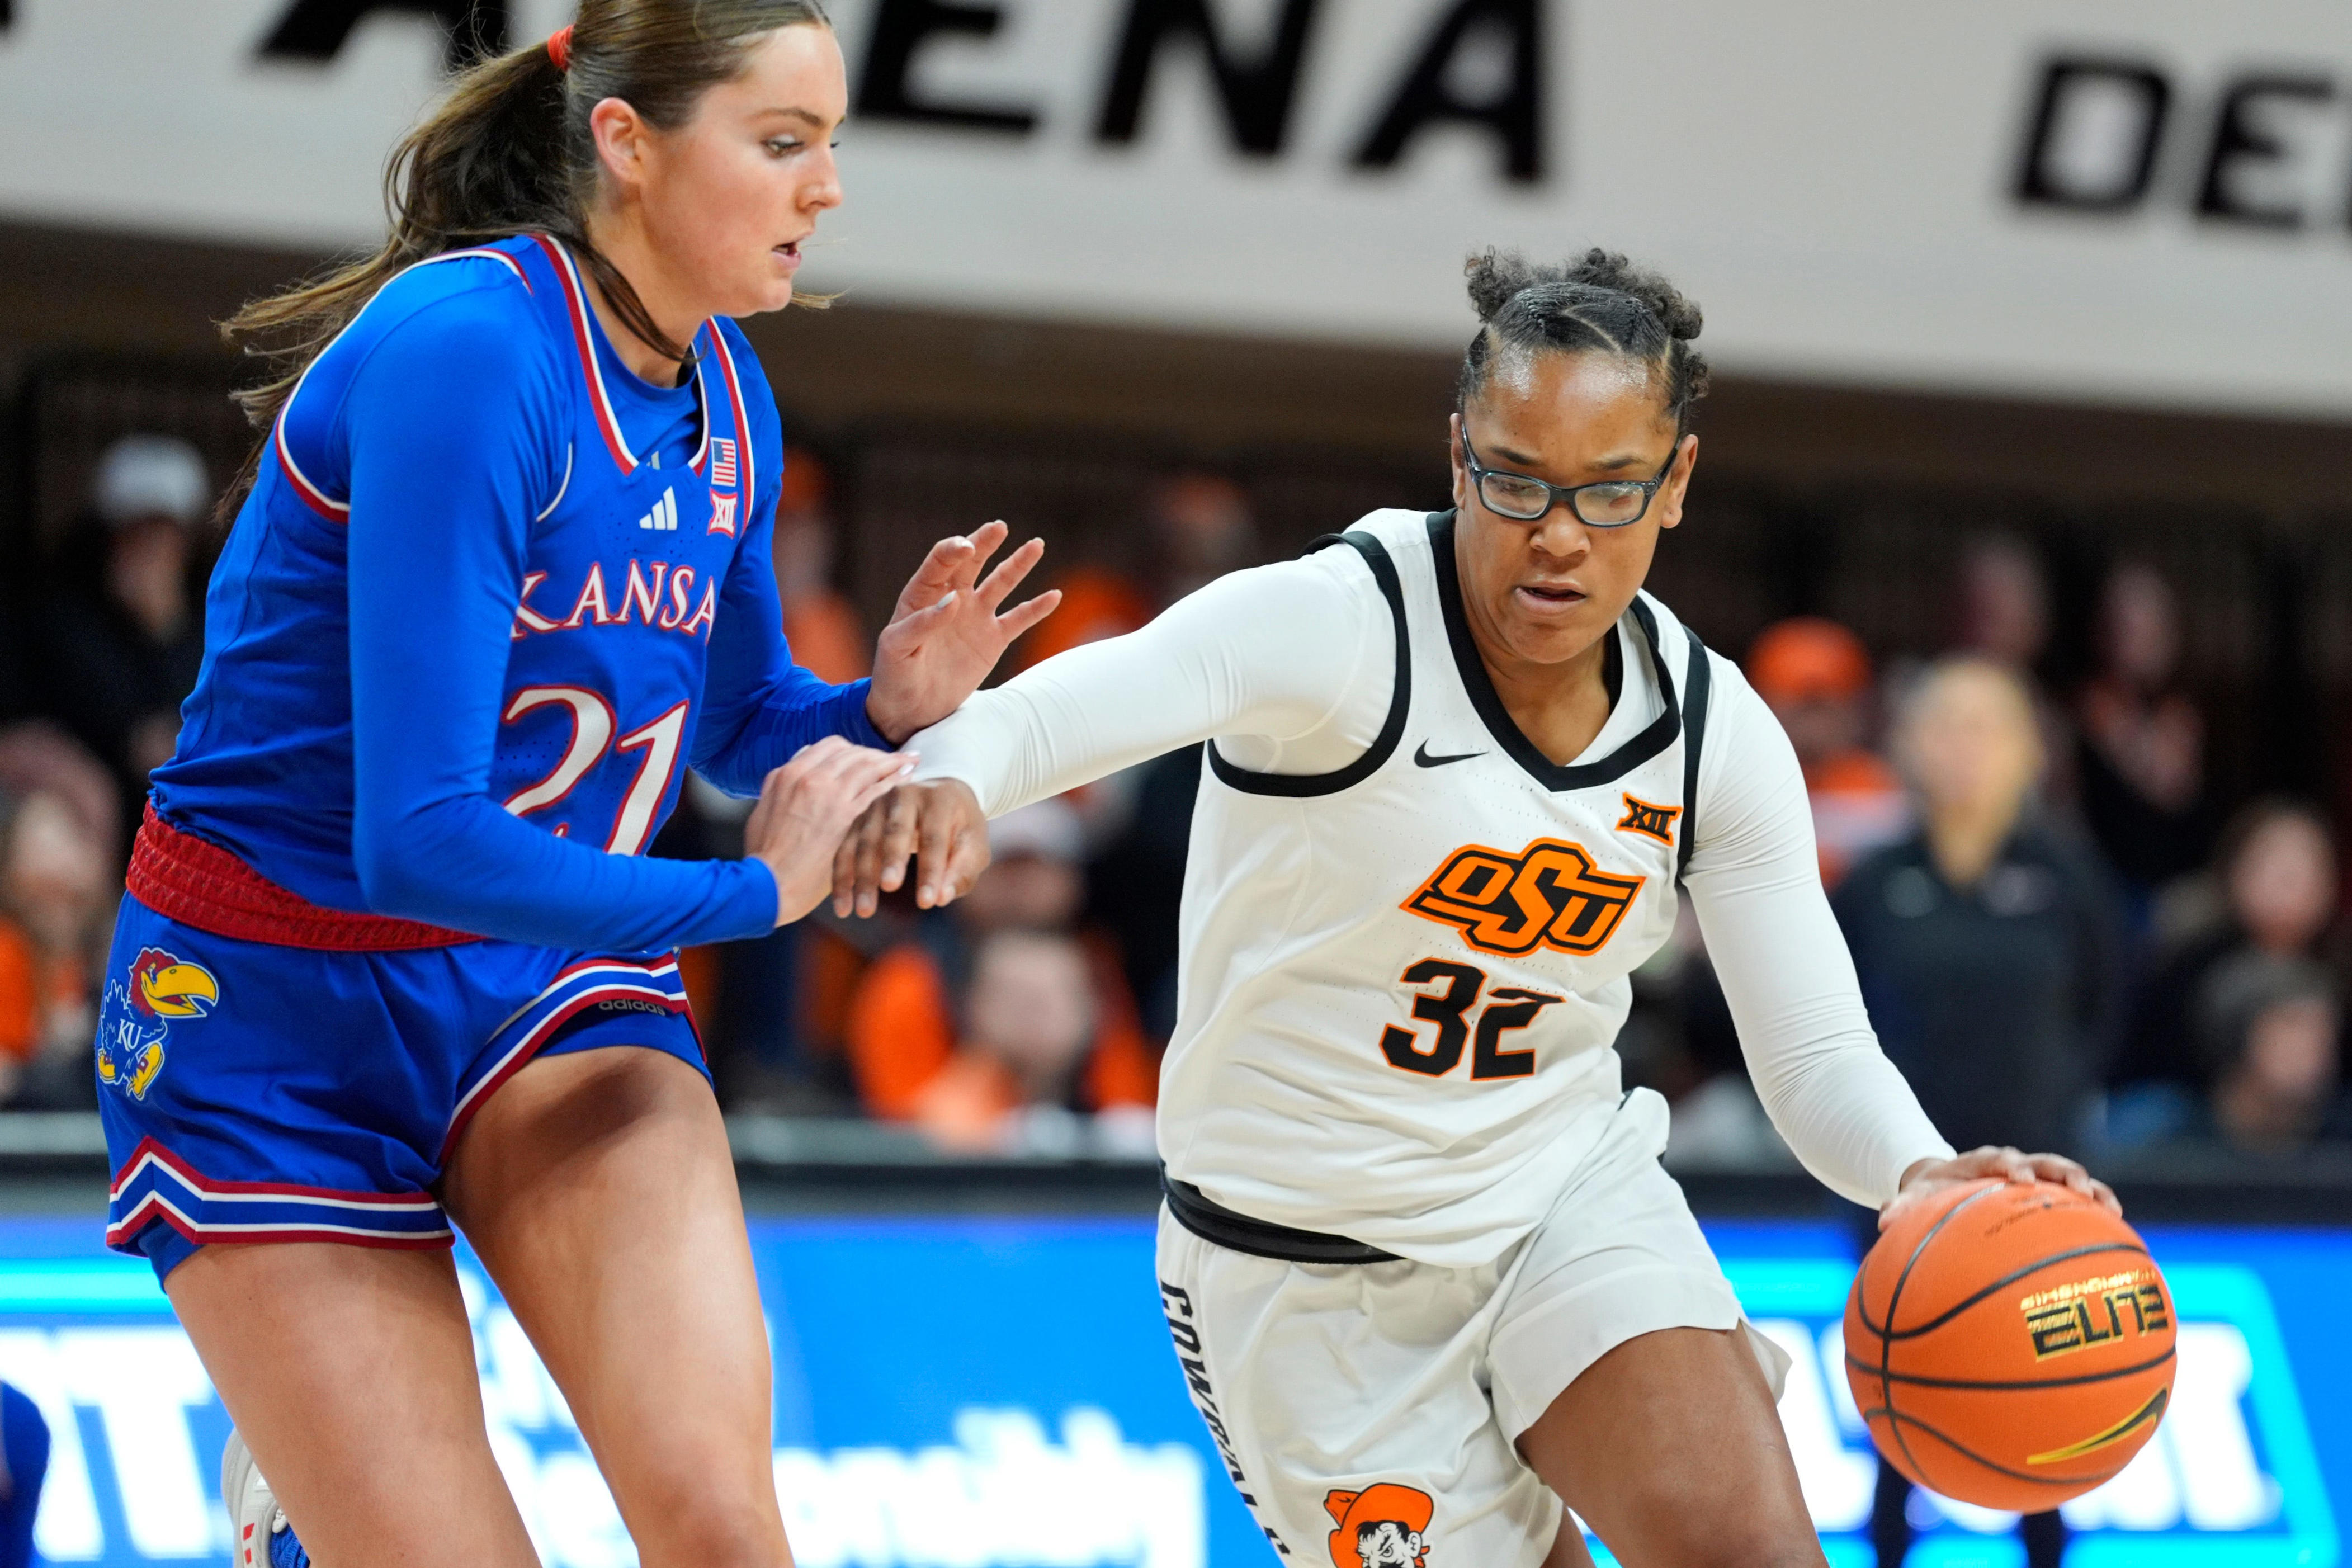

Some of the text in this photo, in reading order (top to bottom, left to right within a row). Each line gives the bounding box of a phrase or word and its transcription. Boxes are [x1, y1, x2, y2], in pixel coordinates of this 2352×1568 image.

[243, 0, 2352, 240] ENA DE
[707, 487, 738, 539] XII
[501, 684, 689, 856] 21
[1614, 791, 1683, 847] XII
[1399, 837, 1646, 958] OSU
[116, 1018, 143, 1052] KU
[598, 999, 666, 1016] adidas
[1379, 956, 1566, 1081] 32
[2023, 1283, 2170, 1363] ELITE
